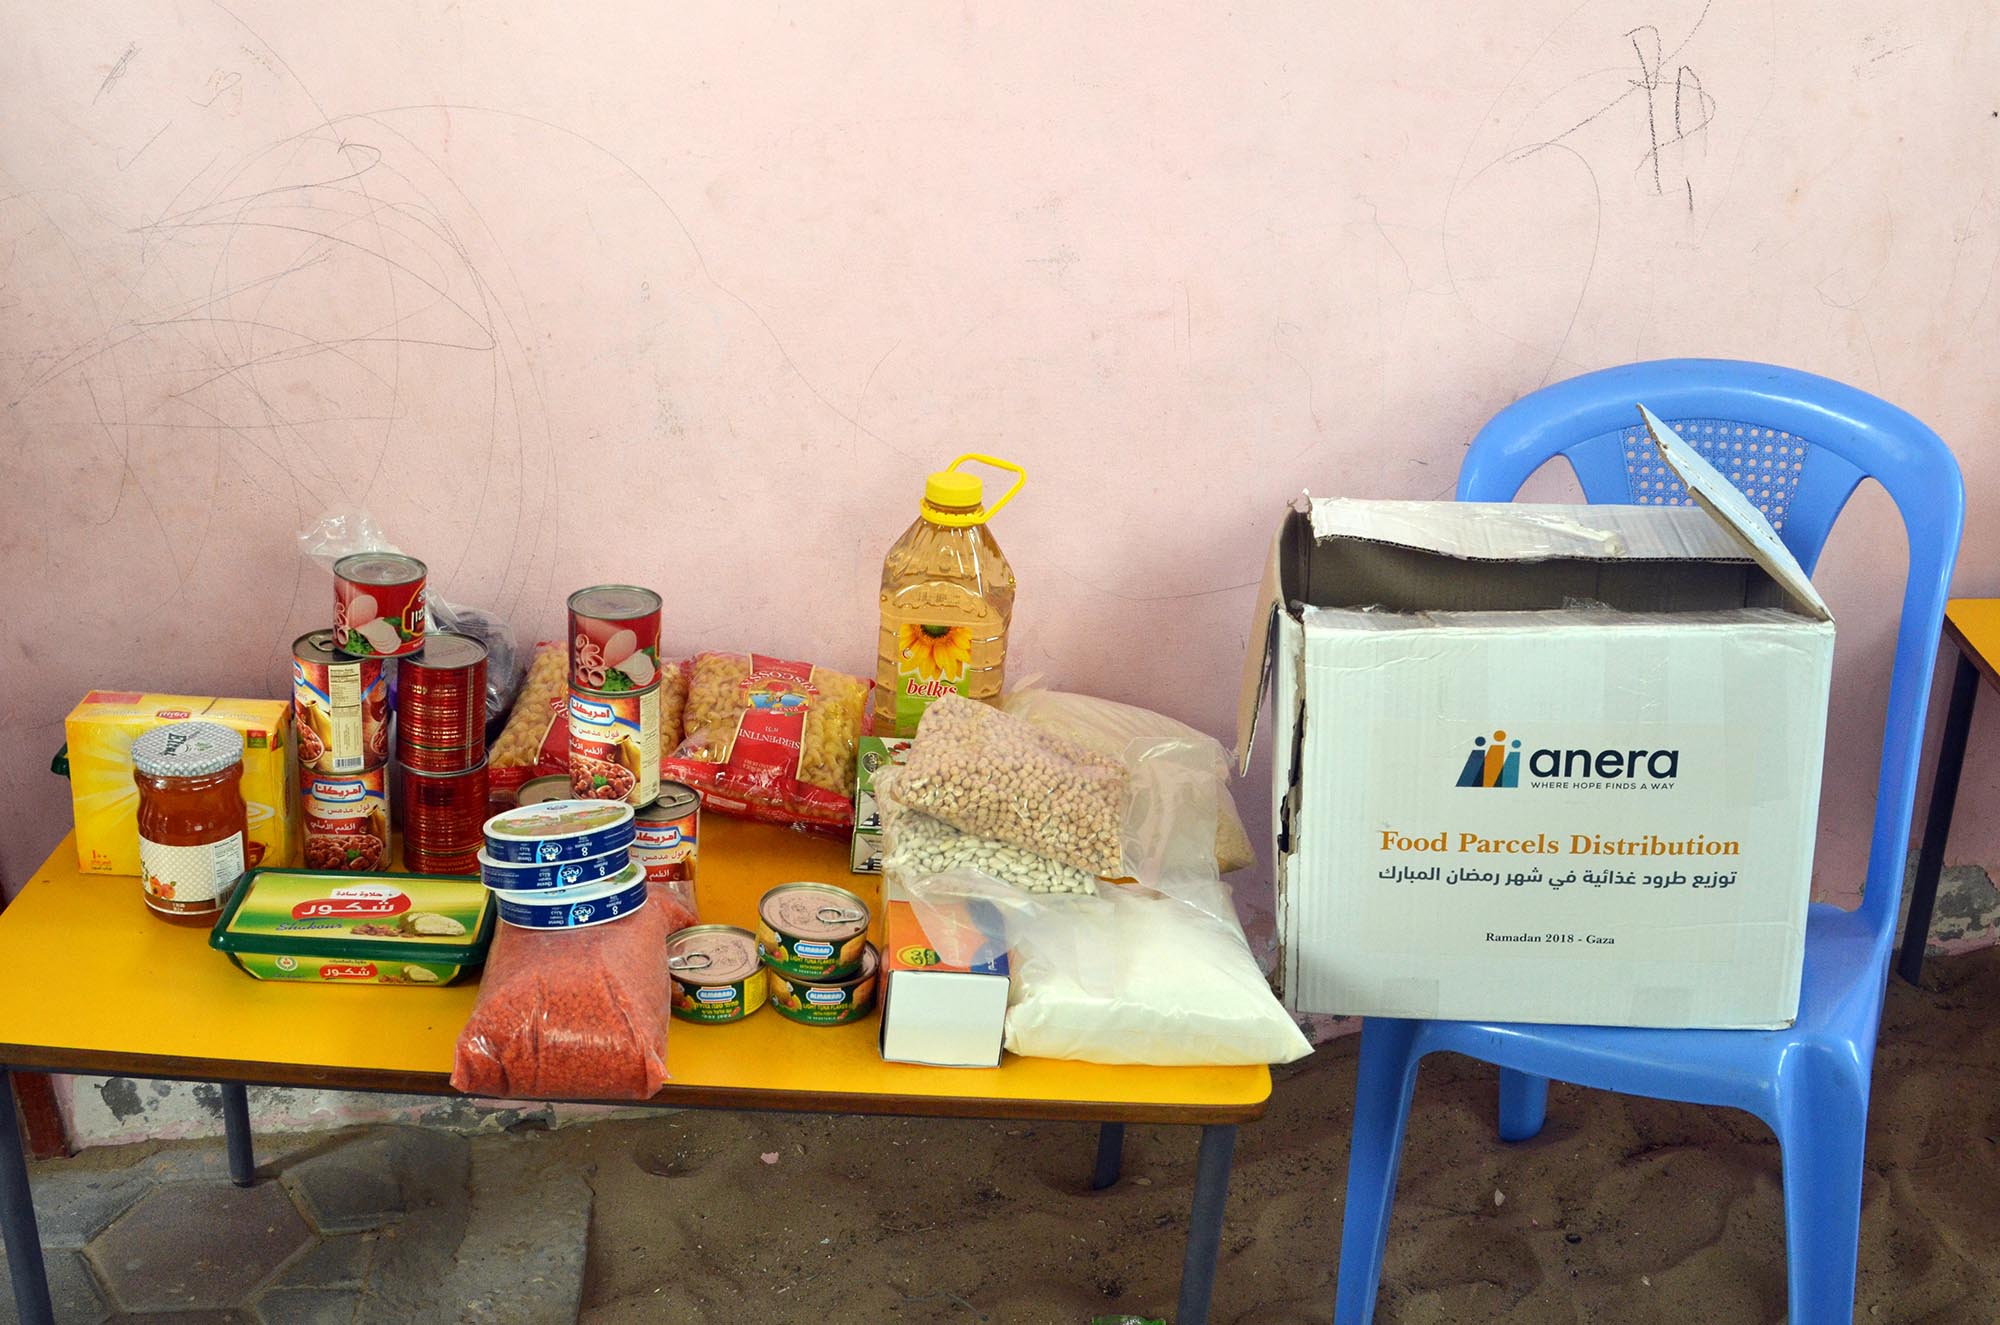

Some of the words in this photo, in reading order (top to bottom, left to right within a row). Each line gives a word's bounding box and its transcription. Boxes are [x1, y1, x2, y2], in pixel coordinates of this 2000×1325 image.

[738, 728, 801, 749] SERPENTINI
[1529, 749, 1679, 779] anera
[1531, 781, 1569, 789] WHERE
[1573, 782, 1601, 790] HOPE
[1605, 782, 1637, 790] FINDS
[581, 847, 589, 857] 8
[1380, 831, 1448, 852] Food
[1458, 832, 1560, 854] Parcels
[1569, 834, 1741, 856] Distribution
[599, 866, 606, 876] 8
[1378, 866, 1441, 884] المبارك
[1446, 867, 1500, 886] رمضان
[1505, 866, 1543, 886] شهر
[1548, 870, 1576, 890] في
[1583, 869, 1636, 888] غذائية
[1642, 871, 1687, 889] طرود
[1692, 871, 1738, 889] توزيع
[301, 898, 395, 915] شكور
[612, 905, 619, 915] 8
[1486, 932, 1542, 943] Ramadan
[1545, 934, 1574, 943] 2018
[1586, 934, 1615, 945] Gaza
[324, 965, 370, 976] شكور
